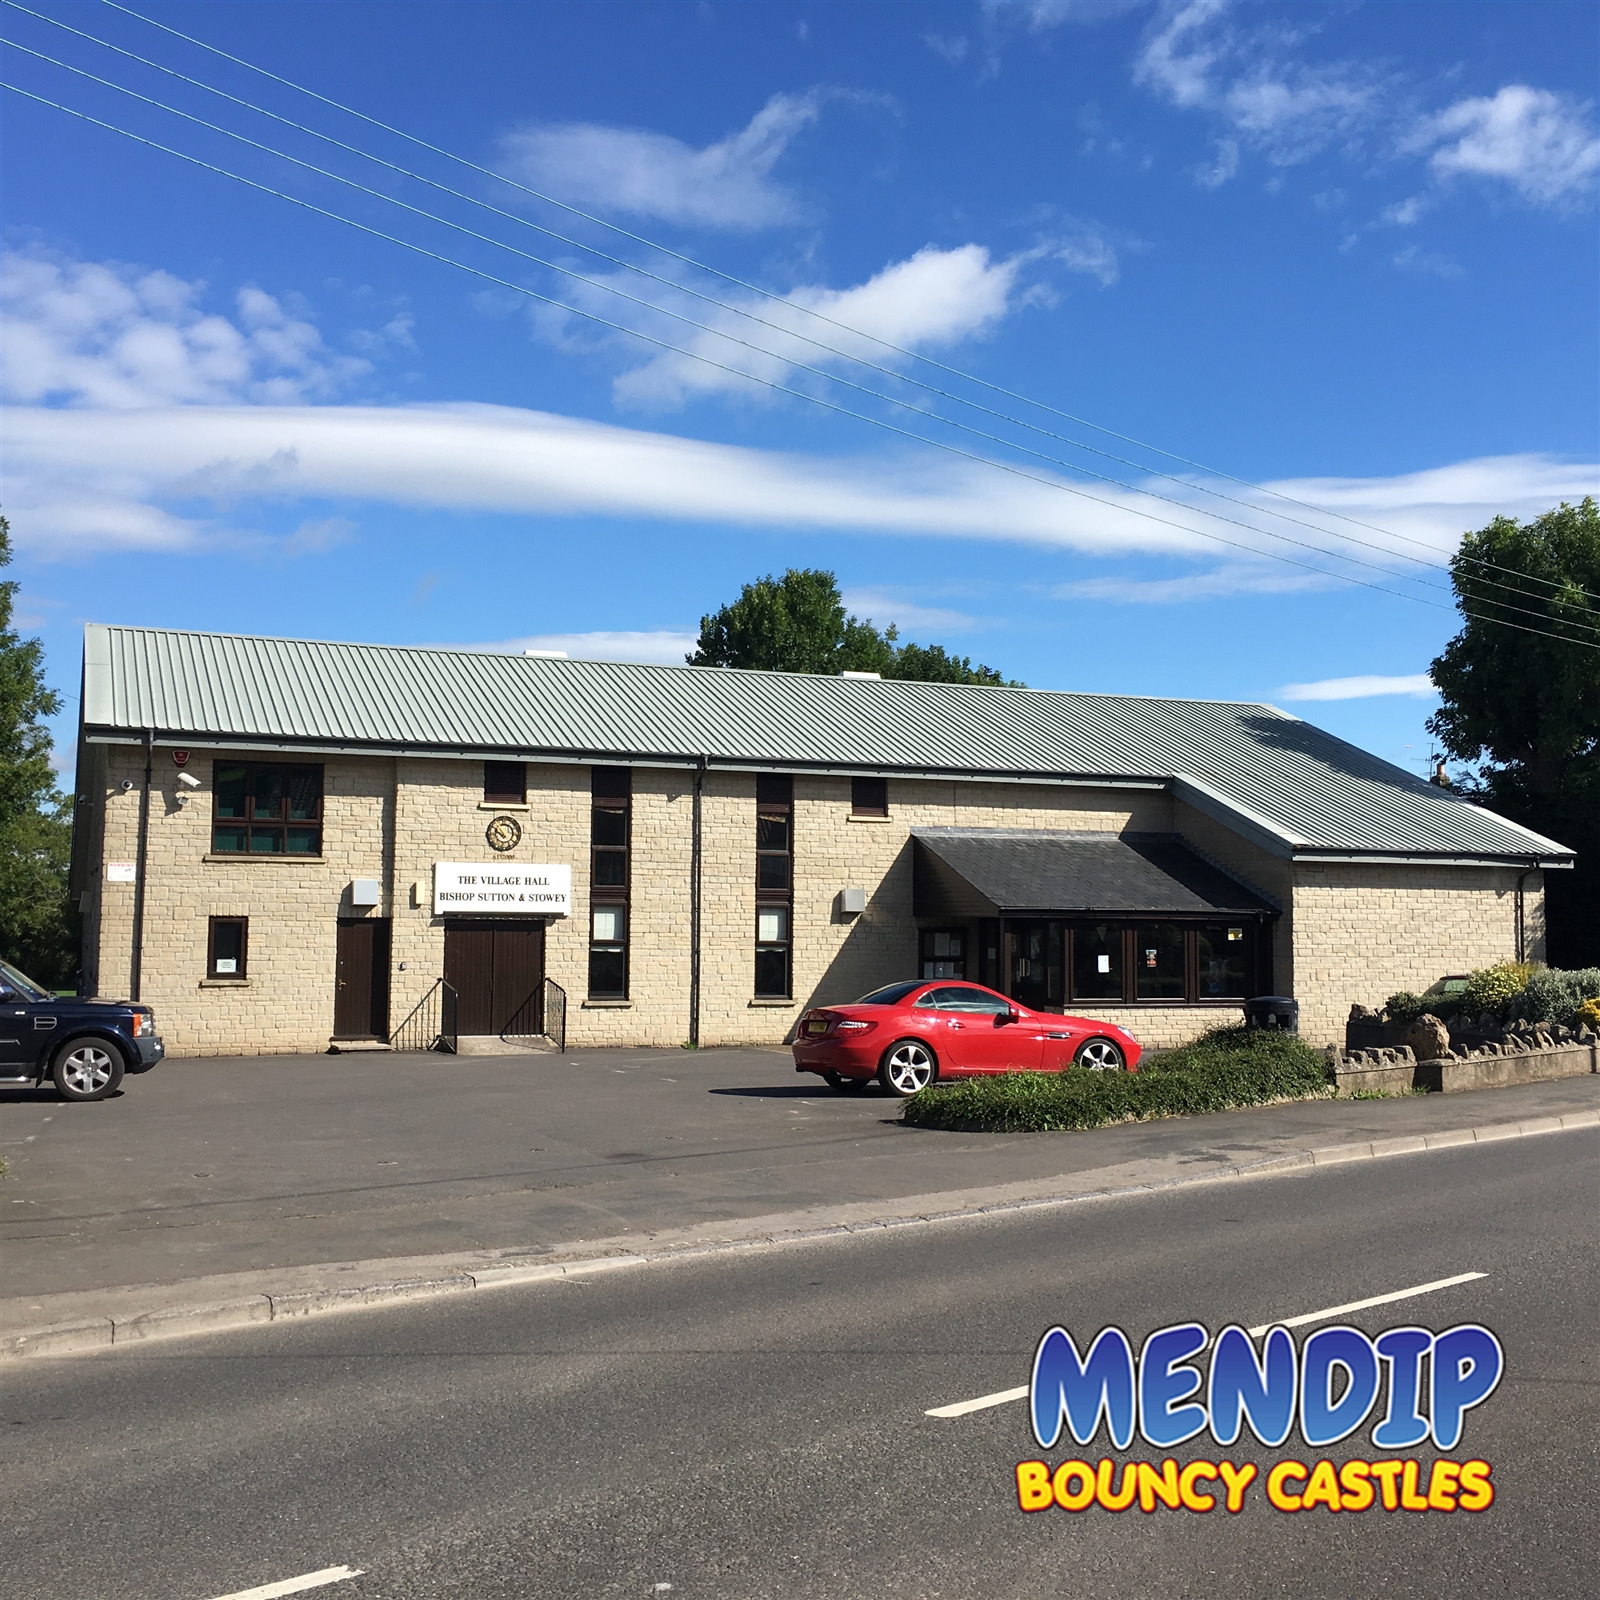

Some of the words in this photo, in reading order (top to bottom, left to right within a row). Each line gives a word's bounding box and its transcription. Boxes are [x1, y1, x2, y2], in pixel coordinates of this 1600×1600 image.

[458, 876, 477, 885] THE
[481, 876, 521, 885] VILLAGE
[524, 877, 550, 886] HALL
[439, 892, 475, 901] BISHOP
[478, 893, 515, 902] SUTTON
[518, 893, 526, 902] &
[528, 893, 567, 903] STOWEY
